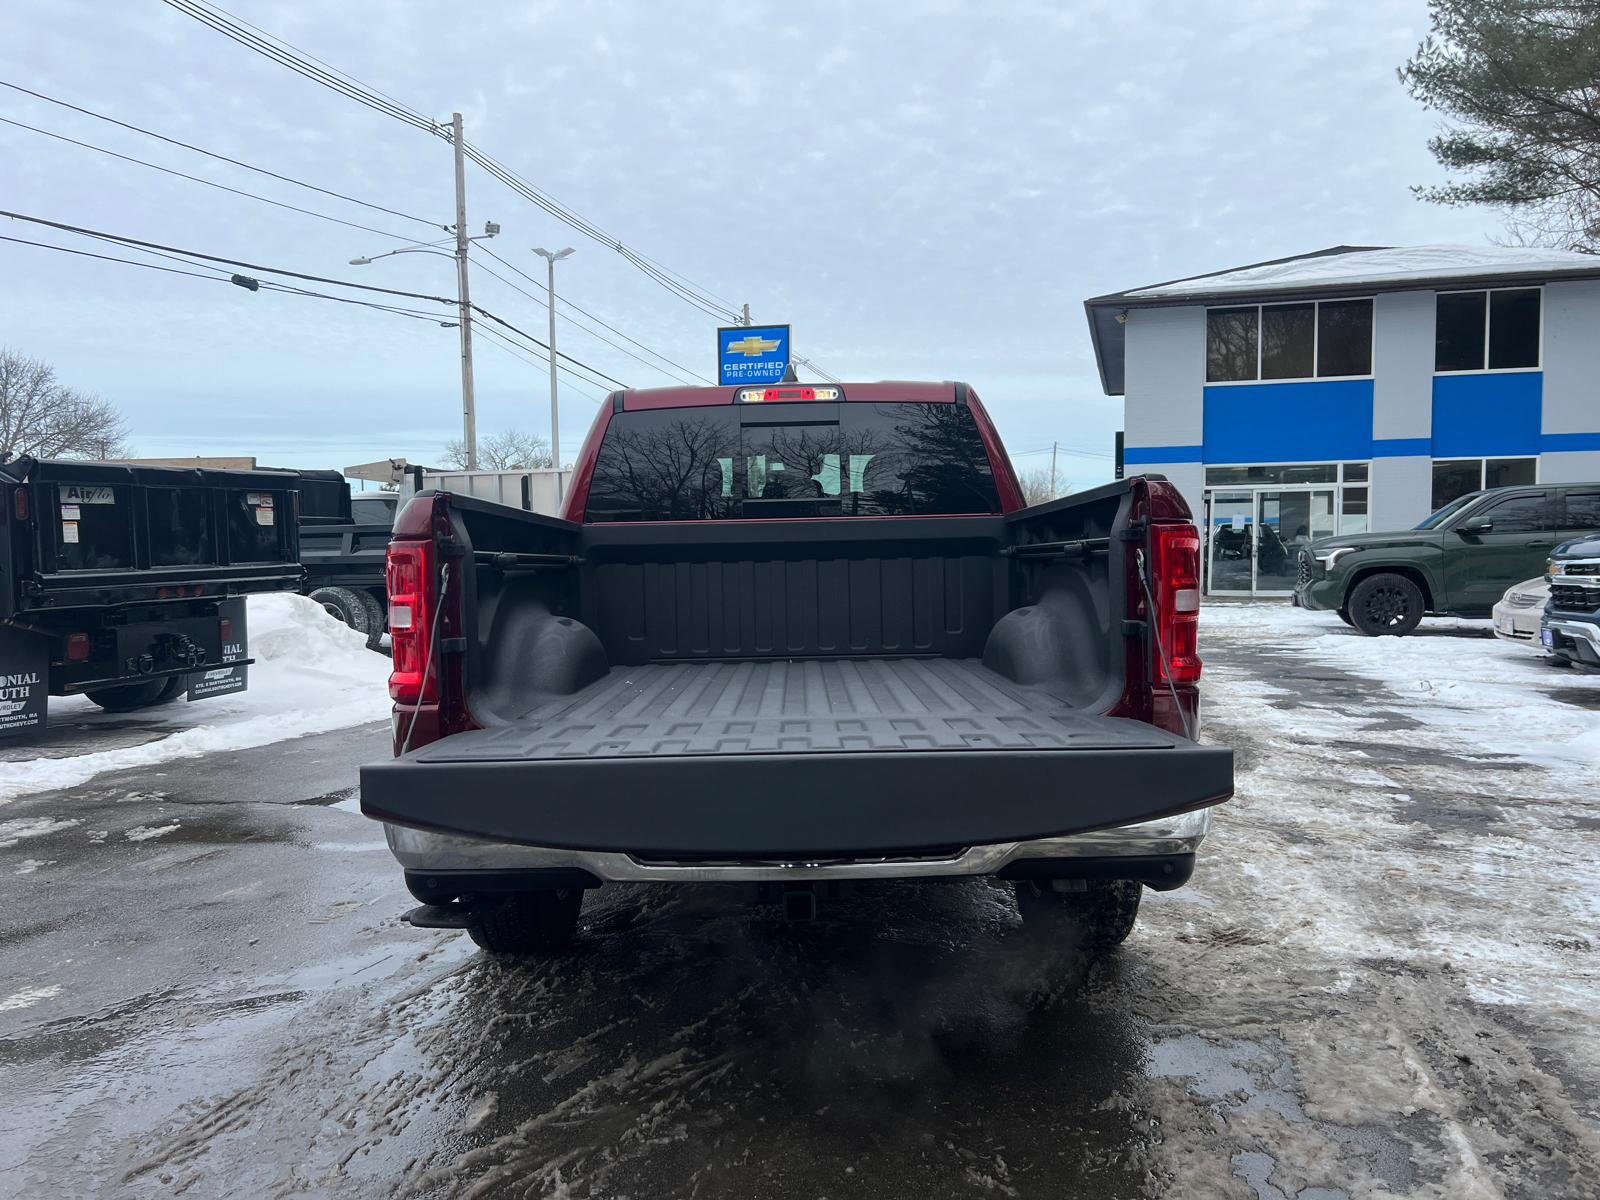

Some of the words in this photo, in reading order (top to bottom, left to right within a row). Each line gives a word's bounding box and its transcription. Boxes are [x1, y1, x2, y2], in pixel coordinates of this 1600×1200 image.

[724, 362, 783, 370] CERTIFIED
[726, 369, 780, 377] PRE-OWNED
[67, 486, 110, 502] Airflo
[0, 714, 28, 722] TMOUTH,
